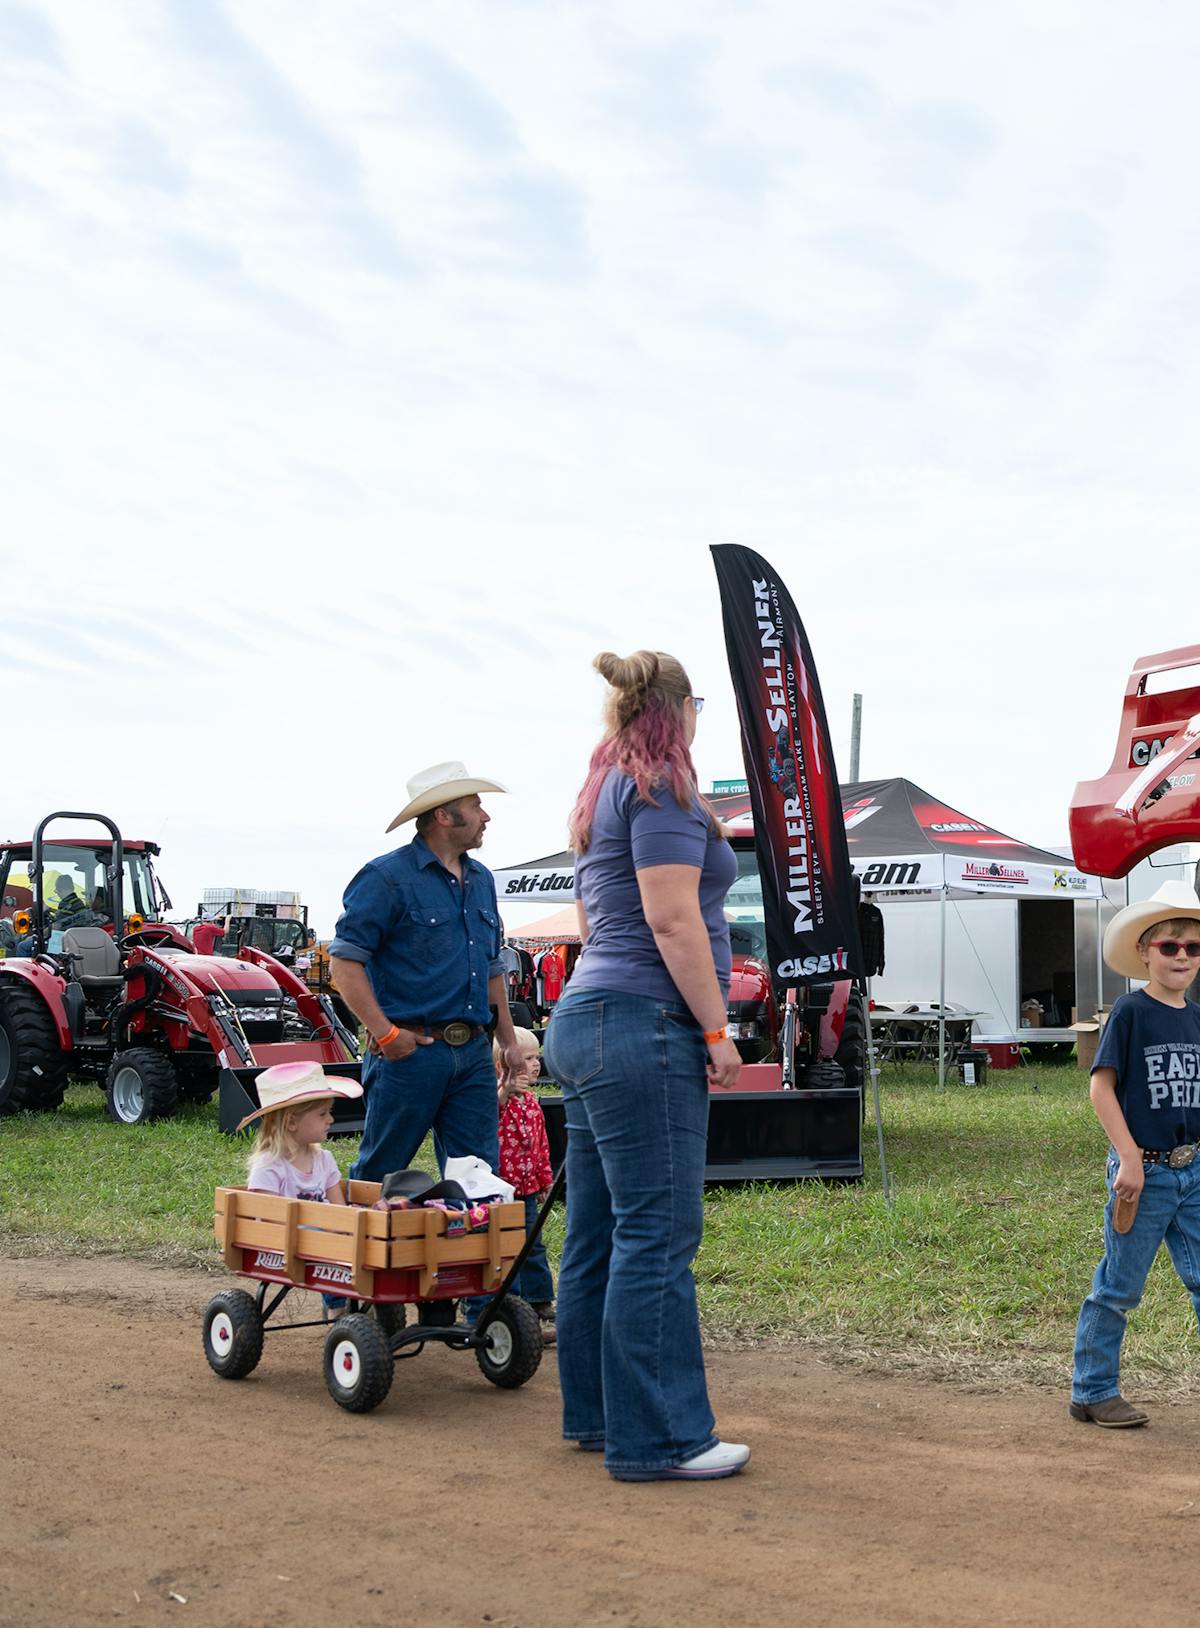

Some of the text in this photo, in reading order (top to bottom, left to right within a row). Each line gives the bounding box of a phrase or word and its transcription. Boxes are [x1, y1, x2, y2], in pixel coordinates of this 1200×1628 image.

[786, 663, 798, 719] SLAYTON
[752, 577, 814, 934] MILLER SELLNER
[794, 740, 805, 770] LAKE
[800, 775, 814, 832] BINGHAM
[931, 823, 971, 832] CASE
[505, 873, 574, 894] ski-doo
[965, 863, 1025, 878] MILLER SELLNER
[814, 880, 825, 925] SLEEPY
[777, 954, 831, 979] CASE
